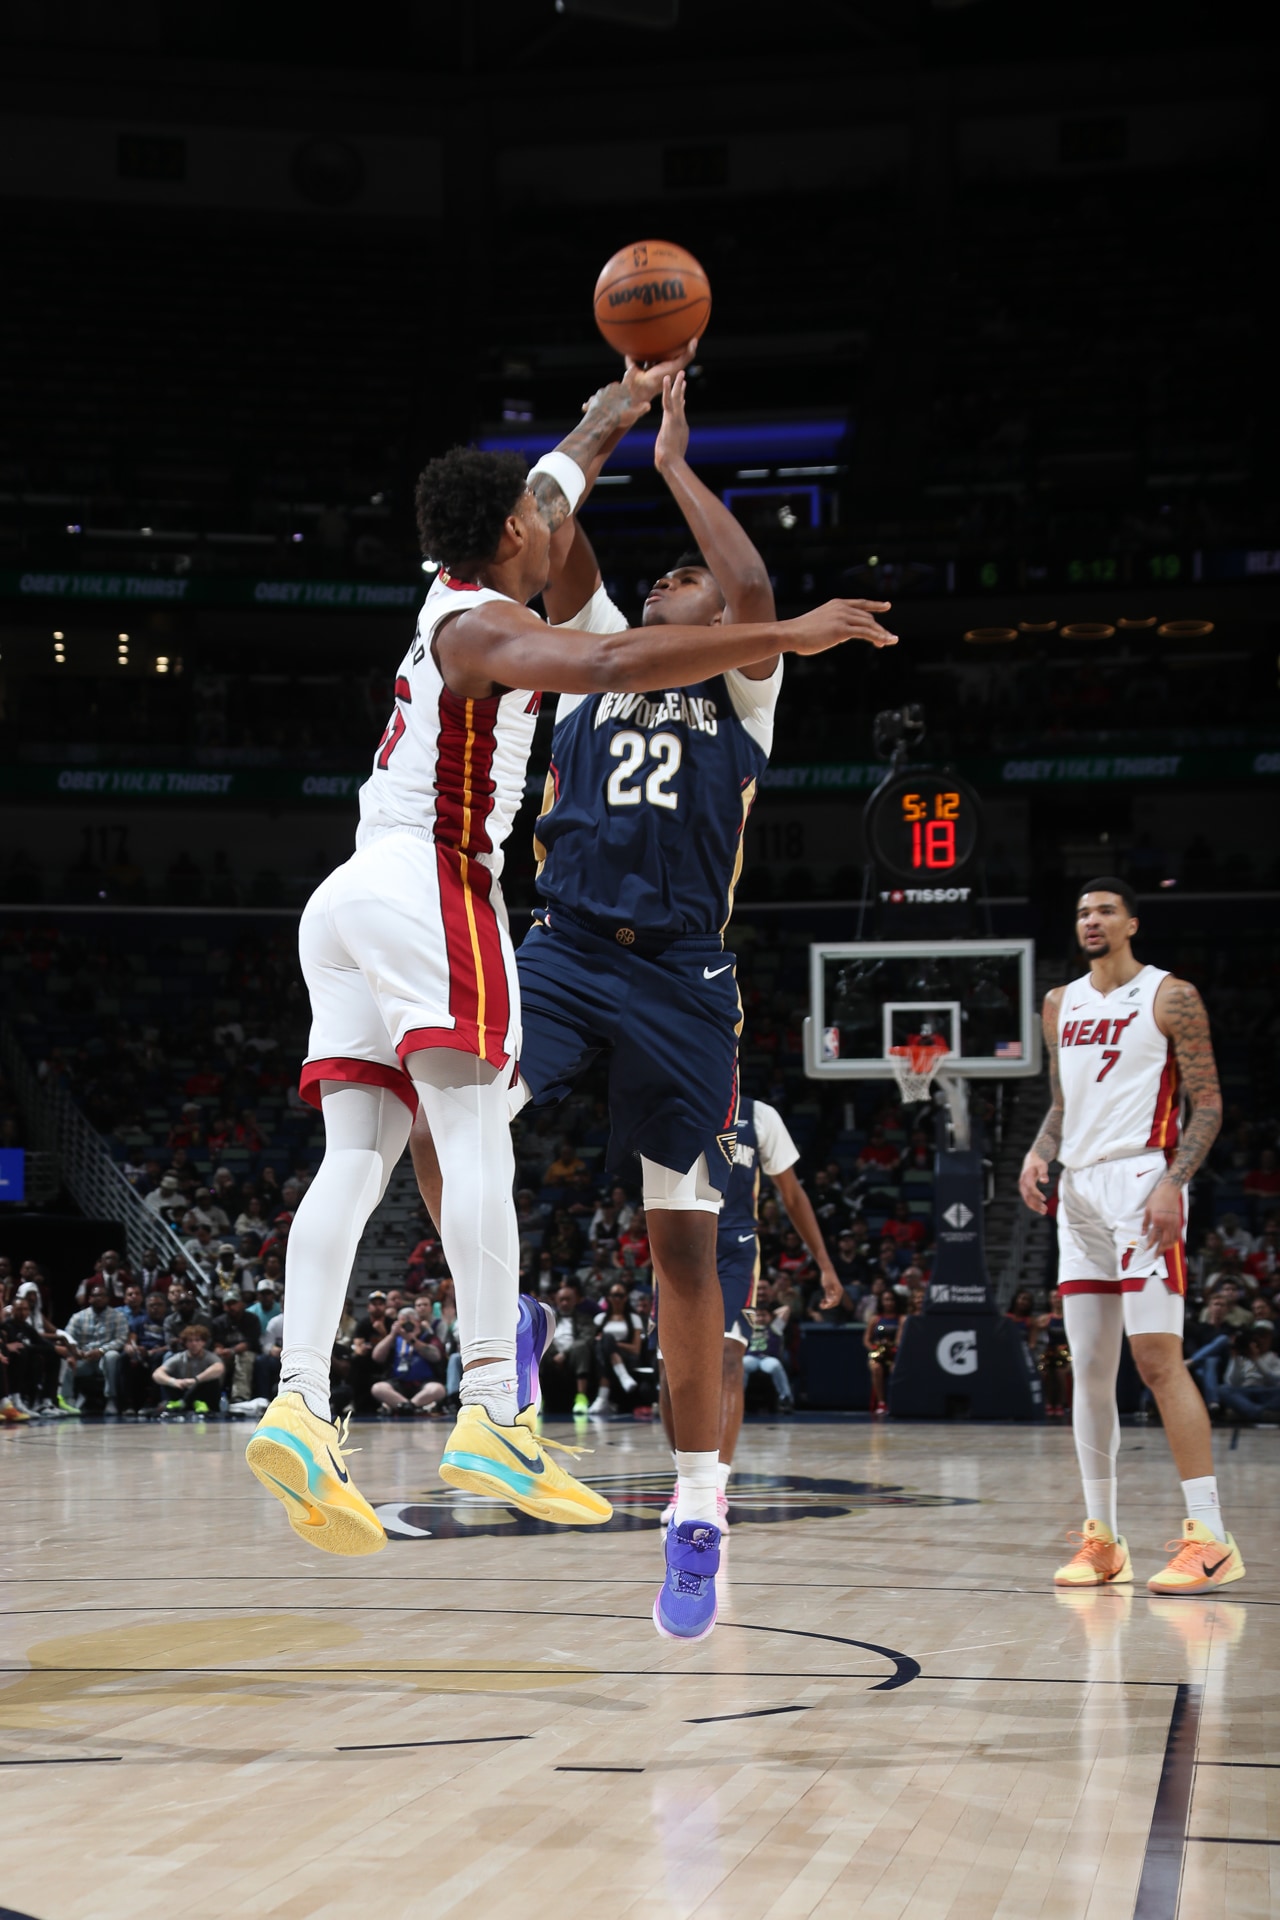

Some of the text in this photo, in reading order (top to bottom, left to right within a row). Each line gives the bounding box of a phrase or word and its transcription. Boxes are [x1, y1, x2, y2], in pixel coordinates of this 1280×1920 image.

[608, 278, 686, 308] Wilson
[19, 573, 70, 594] OBEY
[125, 576, 189, 599] THIRST
[254, 581, 303, 600] OBEY
[355, 584, 418, 604] THIRST
[594, 691, 645, 730] NEW
[57, 770, 110, 791] OBEY
[165, 772, 234, 794] THIRST
[607, 729, 682, 810] 22
[1001, 759, 1055, 781] OBEY
[1112, 755, 1183, 777] THIRST
[302, 775, 352, 796] OBEY
[902, 792, 960, 821] 5:12
[80, 824, 128, 863] 117
[755, 821, 804, 861] 118
[912, 820, 956, 869] 18
[904, 887, 971, 903] TISSOT
[1061, 1011, 1138, 1048] HEAT
[1096, 1049, 1122, 1083] 7
[936, 1330, 978, 1376] G
